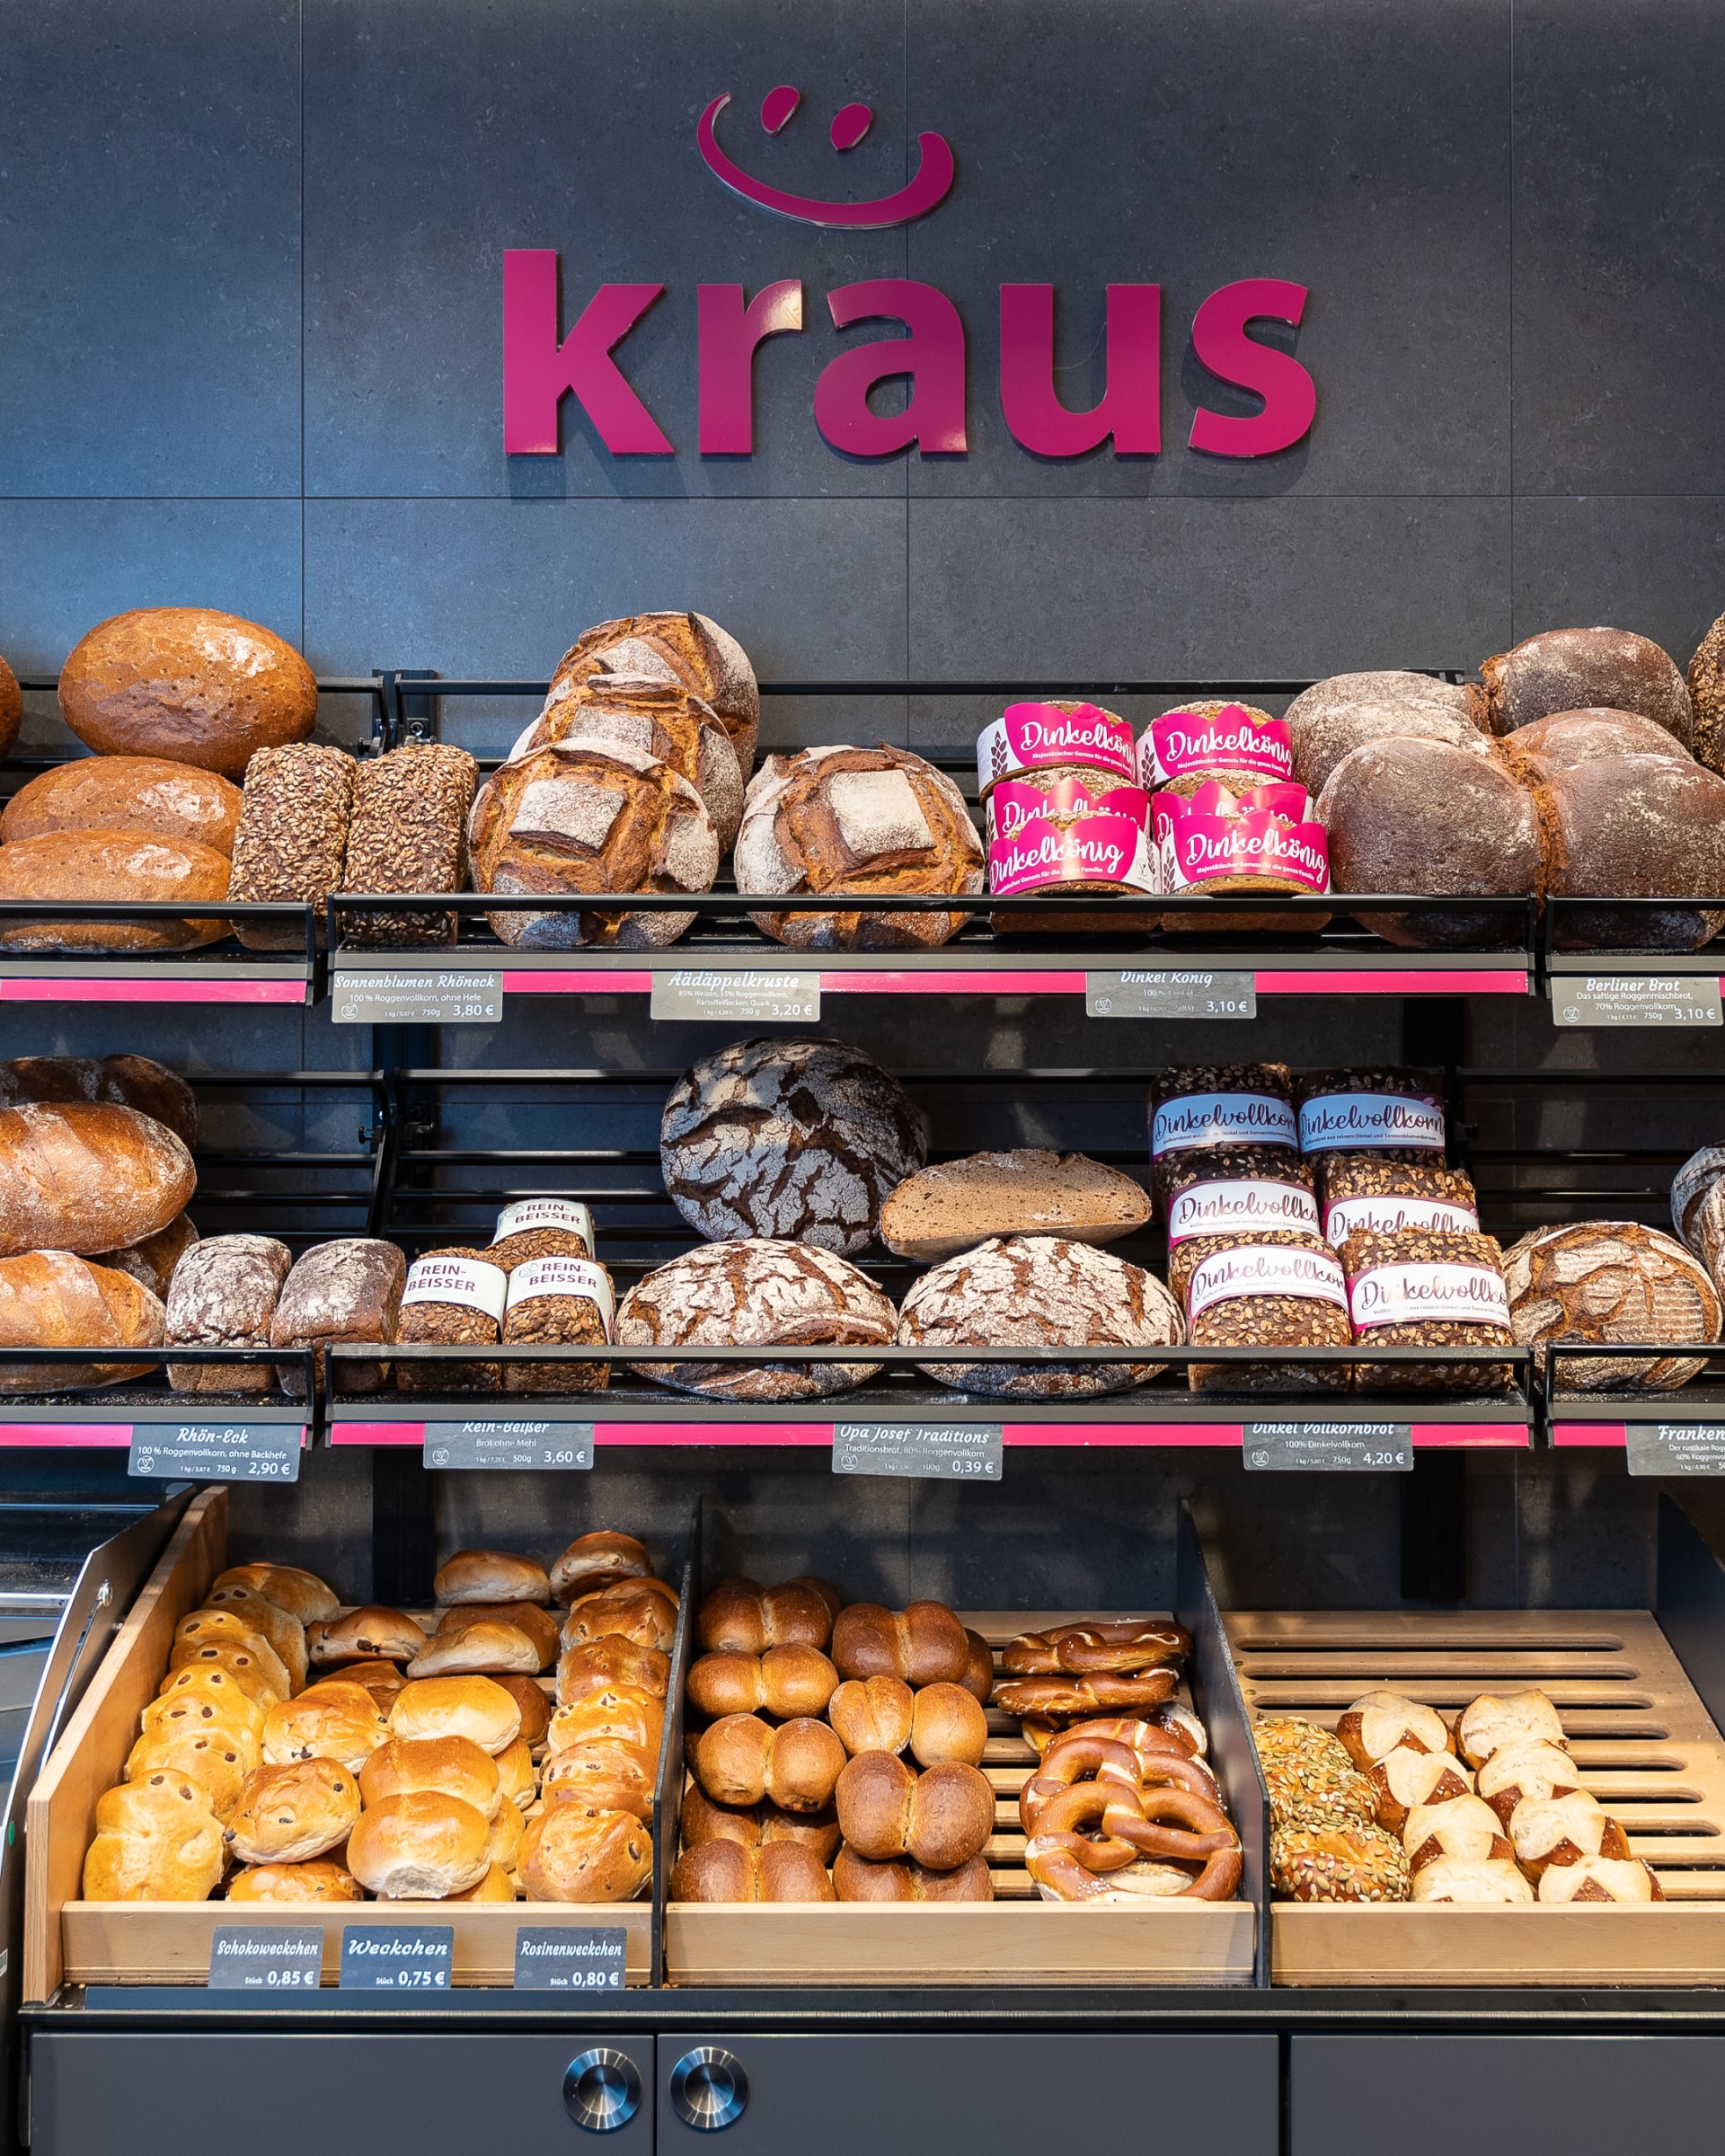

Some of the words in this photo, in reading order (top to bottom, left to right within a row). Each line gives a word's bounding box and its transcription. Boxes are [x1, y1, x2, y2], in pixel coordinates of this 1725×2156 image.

[502, 247, 1317, 457] kraus
[1166, 726, 1292, 776] Dinkelkönig
[1185, 828, 1326, 884] Dinkelkönig
[990, 835, 1124, 893] Dinkelkönig
[335, 975, 433, 989] Sonnenblumen
[437, 974, 495, 988] Rhöneck
[668, 971, 799, 991] Aädäppelkruste
[1120, 971, 1166, 984] Dinkel
[1586, 978, 1645, 992] Berliner
[1649, 978, 1681, 992] Brot
[349, 994, 364, 1002] 100
[366, 994, 374, 1002] %
[375, 994, 439, 1003] Roggenvollkorn,
[441, 994, 461, 1002] ohne
[463, 994, 482, 1002] Hefe
[1593, 992, 1620, 1002] saftige
[1621, 992, 1694, 1002] Roggenmischbrot,
[421, 1009, 441, 1017] 750g
[452, 1004, 482, 1017] 3,80
[485, 1004, 495, 1016] €
[771, 1004, 801, 1017] 3,20
[803, 1004, 813, 1016] €
[1207, 1001, 1236, 1013] 3,10
[1238, 1001, 1248, 1012] €
[1595, 1003, 1613, 1011] 70%
[1643, 1012, 1663, 1021] 750g
[1675, 1008, 1703, 1021] 3,10
[1706, 1008, 1716, 1020] €
[526, 1203, 571, 1212] REIN-
[515, 1213, 580, 1224] BEISSER
[420, 1265, 467, 1276] REIN-
[542, 1263, 588, 1273] REIN-
[407, 1278, 475, 1293] BEISSER
[528, 1275, 597, 1288] BEISSER
[176, 1427, 249, 1444] Rhön-Eck
[870, 1427, 912, 1443] Josef
[1252, 1423, 1297, 1435] Dinkel
[1303, 1423, 1394, 1435] Vollkornbrot
[476, 1439, 493, 1447] Brot
[494, 1438, 515, 1447] ohne
[517, 1438, 537, 1447] Mehl
[1285, 1441, 1307, 1449] 100%
[1668, 1444, 1681, 1452] Der
[137, 1446, 153, 1454] 100
[163, 1447, 227, 1458] Roggenvollkorn,
[229, 1450, 250, 1458] ohne
[251, 1450, 288, 1460] Backhefe
[513, 1455, 532, 1463] 500g
[544, 1451, 573, 1464] 3,60
[576, 1451, 586, 1462] €
[1332, 1456, 1351, 1465] 750g
[1363, 1452, 1393, 1465] 4,20
[1395, 1453, 1405, 1464] €
[248, 1462, 279, 1475] 2,90
[281, 1462, 291, 1475] €
[952, 1460, 982, 1474] 0,39
[985, 1462, 994, 1473] €
[217, 1939, 318, 1957] Schokoweckchen
[349, 1939, 447, 1956] Weckchen
[520, 1940, 622, 1957] Rosinenweckchen
[244, 1976, 263, 1984] Stück
[268, 1971, 301, 1987] 0,85
[304, 1971, 314, 1985] €
[376, 1976, 394, 1984] Stück
[398, 1971, 431, 1987] 0,75
[435, 1971, 446, 1985] €
[550, 1977, 568, 1986] Stück
[572, 1972, 606, 1988] 0,80
[609, 1972, 619, 1986] €
